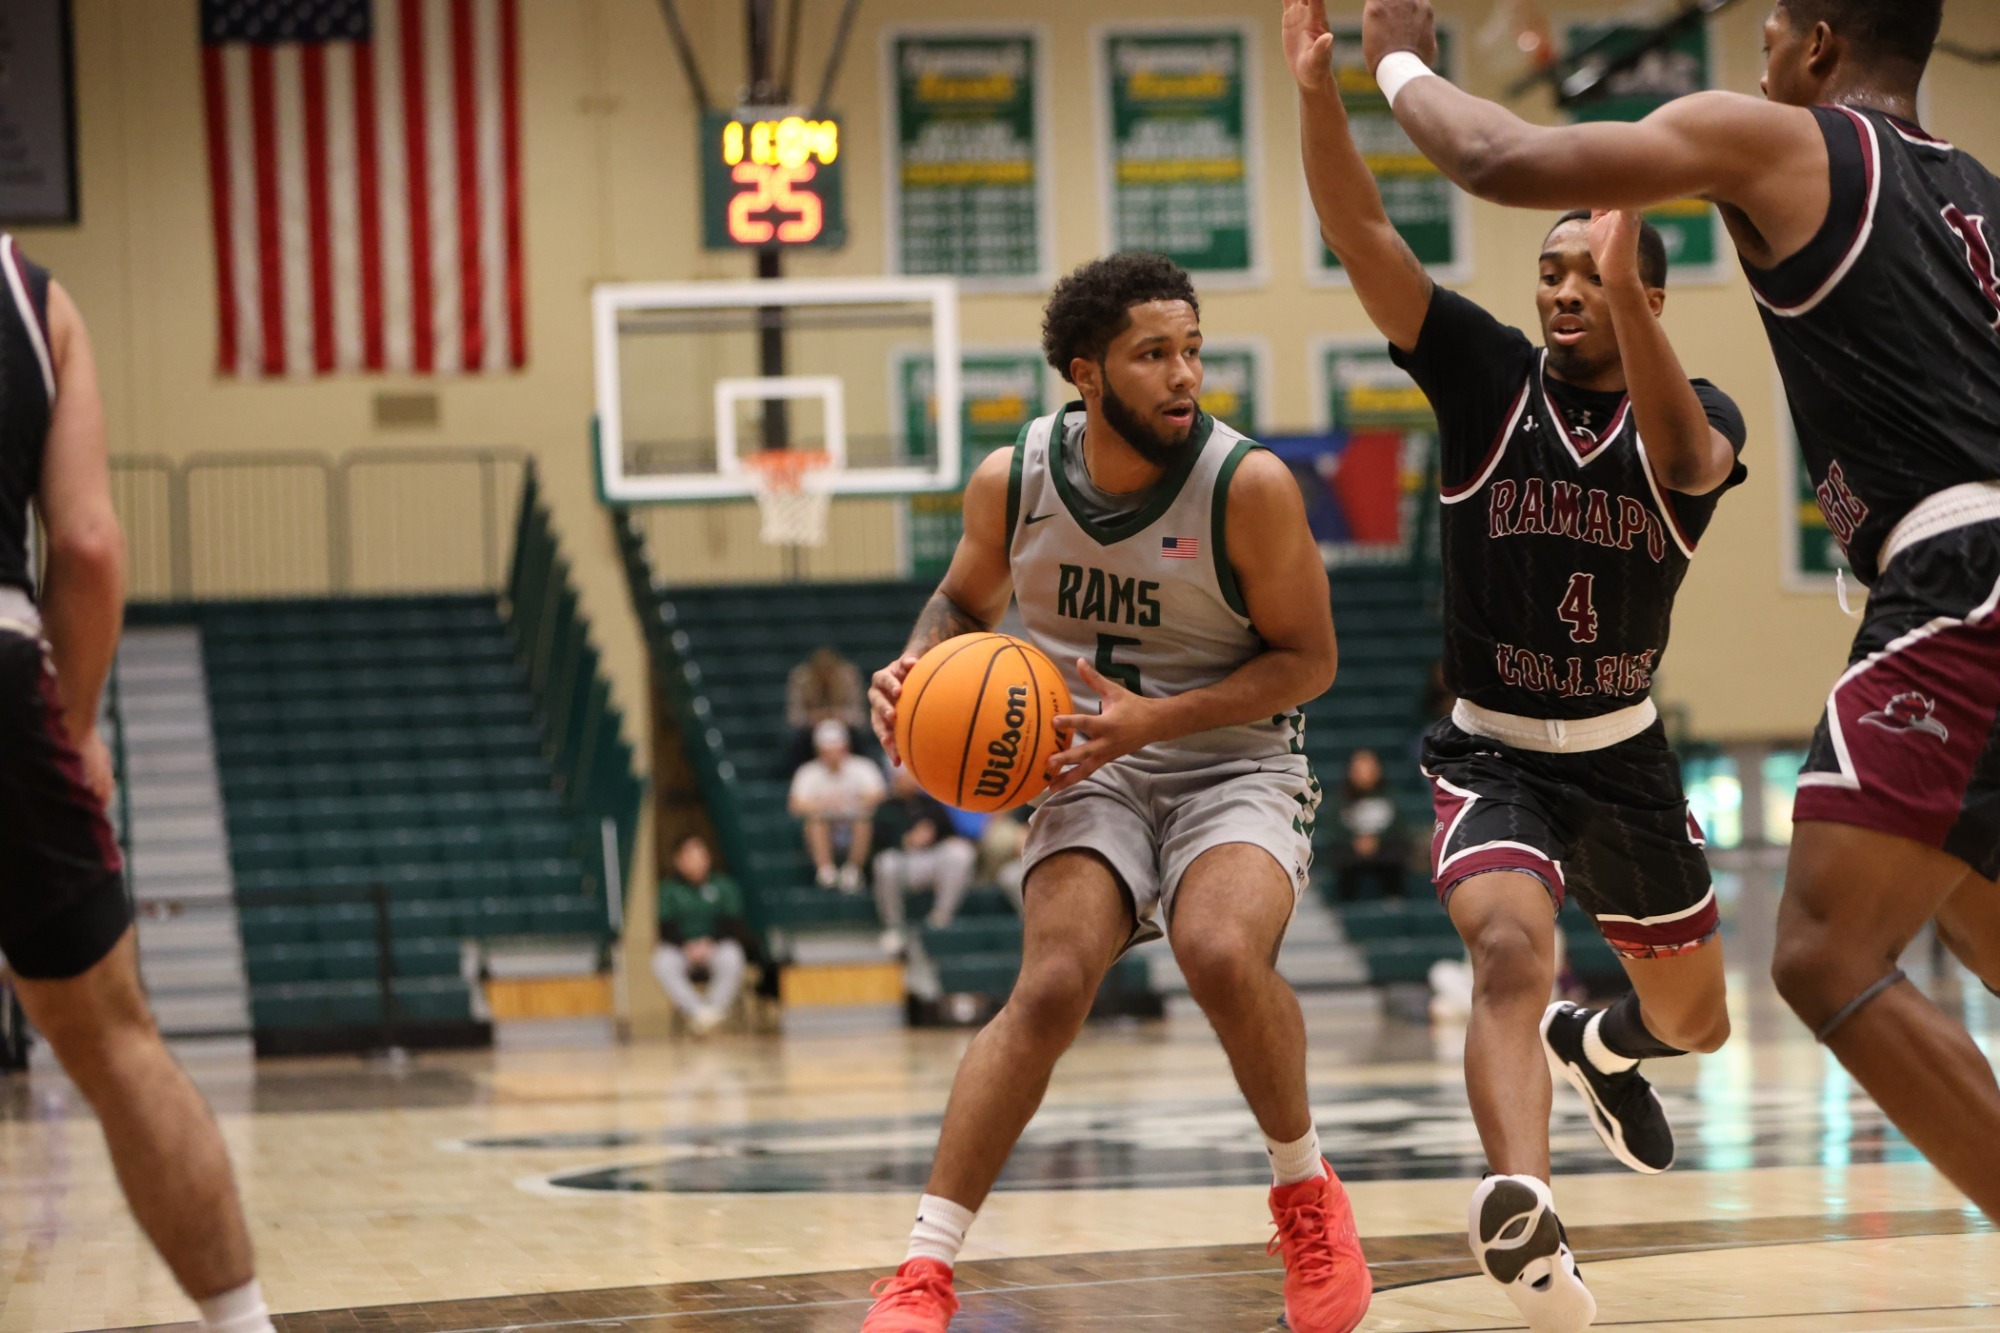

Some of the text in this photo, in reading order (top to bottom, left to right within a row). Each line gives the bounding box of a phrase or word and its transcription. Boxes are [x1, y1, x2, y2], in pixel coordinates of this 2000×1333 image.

[728, 161, 823, 243] 25
[1489, 477, 1666, 563] RAMAPO
[1057, 563, 1161, 627] RAMS
[1557, 572, 1598, 643] 4
[1496, 643, 1657, 698] COLLEGE
[973, 685, 1028, 797] Wilson
